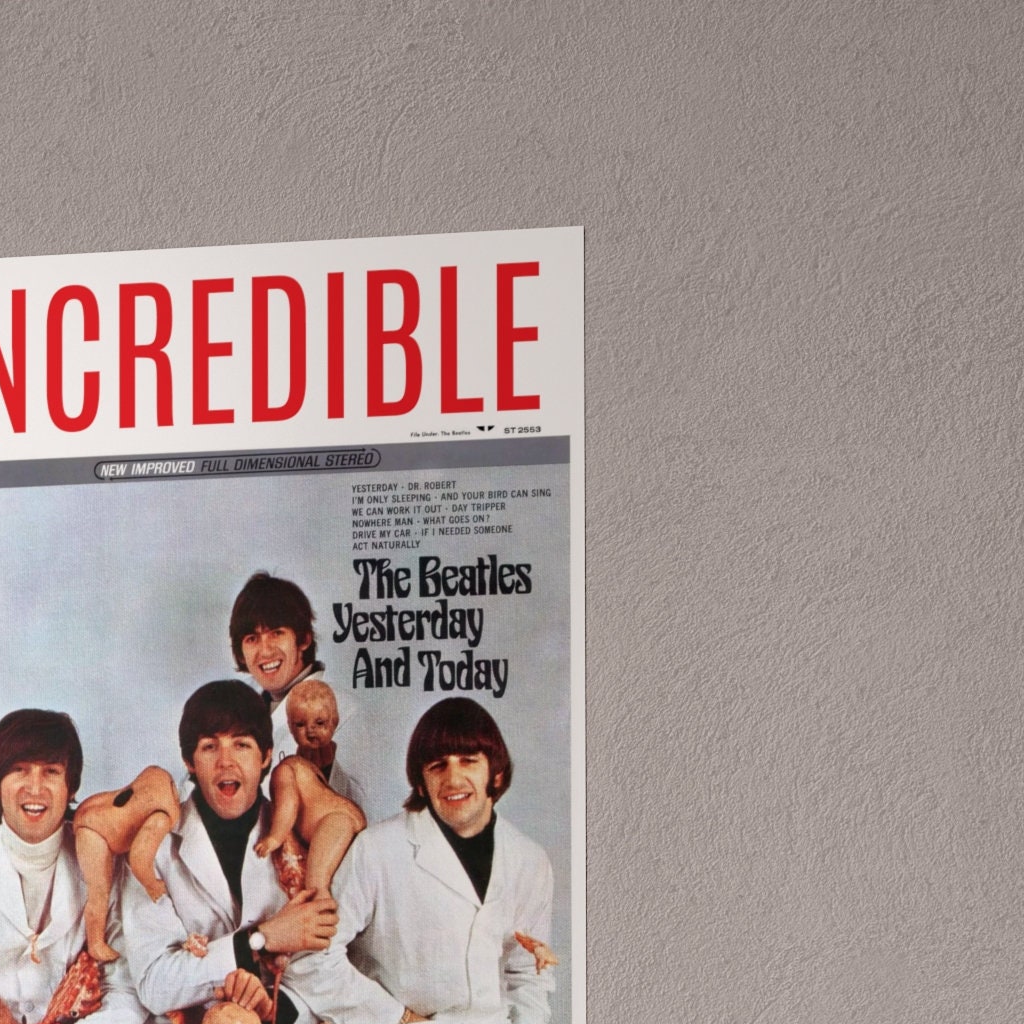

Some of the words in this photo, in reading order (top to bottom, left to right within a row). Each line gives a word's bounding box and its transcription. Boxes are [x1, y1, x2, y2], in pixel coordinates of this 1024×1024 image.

[504, 426, 516, 434] ST
[517, 425, 542, 433] 2553
[100, 463, 125, 477] NEW
[131, 460, 195, 475] IMPROVED
[200, 459, 228, 473] FULL
[233, 455, 320, 471] DIMENSIONAL
[326, 452, 374, 467] STEREO
[352, 483, 398, 493] YESTERDAY
[408, 482, 421, 491] DR.
[424, 481, 456, 490] ROBERT
[352, 496, 365, 505] I'M
[367, 495, 388, 504] ONLY
[391, 493, 431, 503] SLEEPING
[440, 492, 459, 501] AND
[462, 491, 485, 500] YOUR
[487, 490, 508, 499] BIRD
[511, 489, 528, 498] CAN
[531, 488, 551, 497] SING
[352, 508, 364, 517] WE
[366, 507, 384, 516] CAN
[386, 506, 410, 515] WORK
[413, 505, 422, 514] IT
[424, 504, 442, 513] OUT
[451, 503, 468, 512] DAY
[471, 502, 506, 511] TRIPPER
[352, 518, 392, 528] NOWHERE
[394, 517, 413, 526] MAN
[422, 516, 446, 525] WHAT
[448, 515, 470, 524] GOES
[472, 514, 490, 523] ON?
[352, 530, 376, 539] DRIVE
[379, 529, 391, 538] MY
[394, 528, 411, 538] CAR
[421, 527, 429, 536] IF
[438, 526, 471, 536] NEEDED
[474, 525, 513, 534] SOMEONE
[352, 542, 369, 551] ACT
[371, 540, 421, 550] NATURALLY
[353, 557, 411, 600] The
[419, 554, 532, 597] Beatles
[332, 599, 484, 648] Yesterday
[352, 646, 411, 689] And
[417, 650, 509, 699] Today
